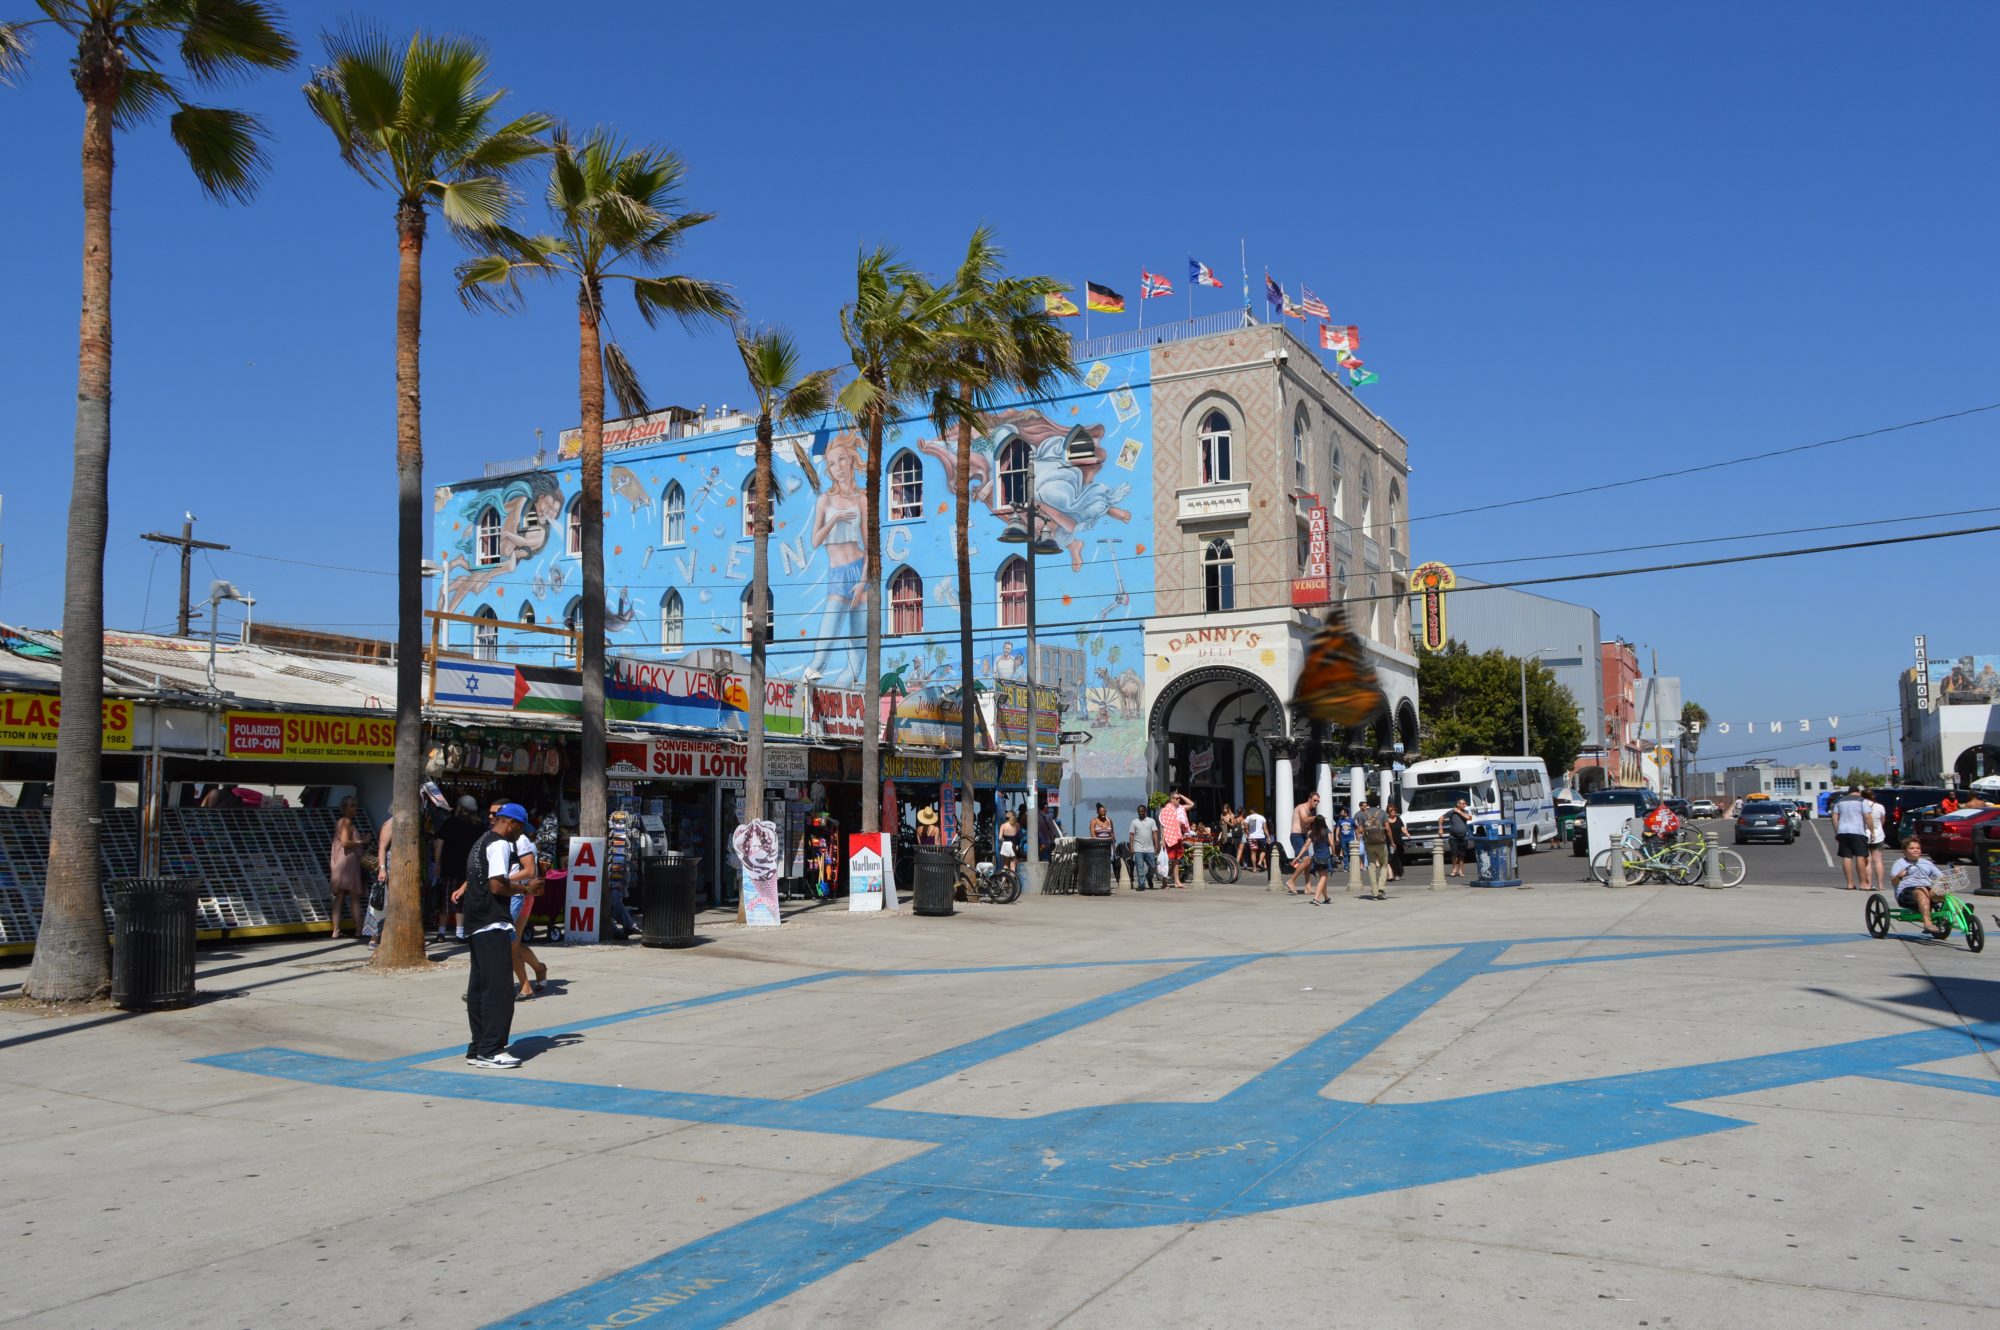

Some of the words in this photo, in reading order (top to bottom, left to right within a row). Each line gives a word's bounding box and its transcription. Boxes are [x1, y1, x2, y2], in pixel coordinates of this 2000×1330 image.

[603, 420, 667, 445] amesun
[1294, 580, 1326, 590] VENICE
[1168, 627, 1263, 653] DANNY'S
[1198, 647, 1232, 658] DELI
[1916, 637, 1926, 707] TATTOO
[615, 663, 675, 694] LUCKY
[685, 671, 742, 703] VENICE
[763, 682, 794, 708] ORE
[1016, 687, 1057, 710] RETALS
[28, 732, 38, 740] IN
[41, 733, 58, 741] VEN
[106, 735, 127, 744] 1982
[234, 724, 281, 736] POLARIZED
[286, 719, 397, 747] SUNGLASS
[234, 737, 280, 749] CLIP-ON
[655, 740, 721, 753] CONVENIENCE
[730, 744, 748, 754] STO
[653, 752, 693, 776] SUN
[884, 756, 905, 777] SURF
[908, 758, 941, 778] LESSONS
[852, 855, 880, 872] Marlboro
[569, 842, 597, 932] ATM
